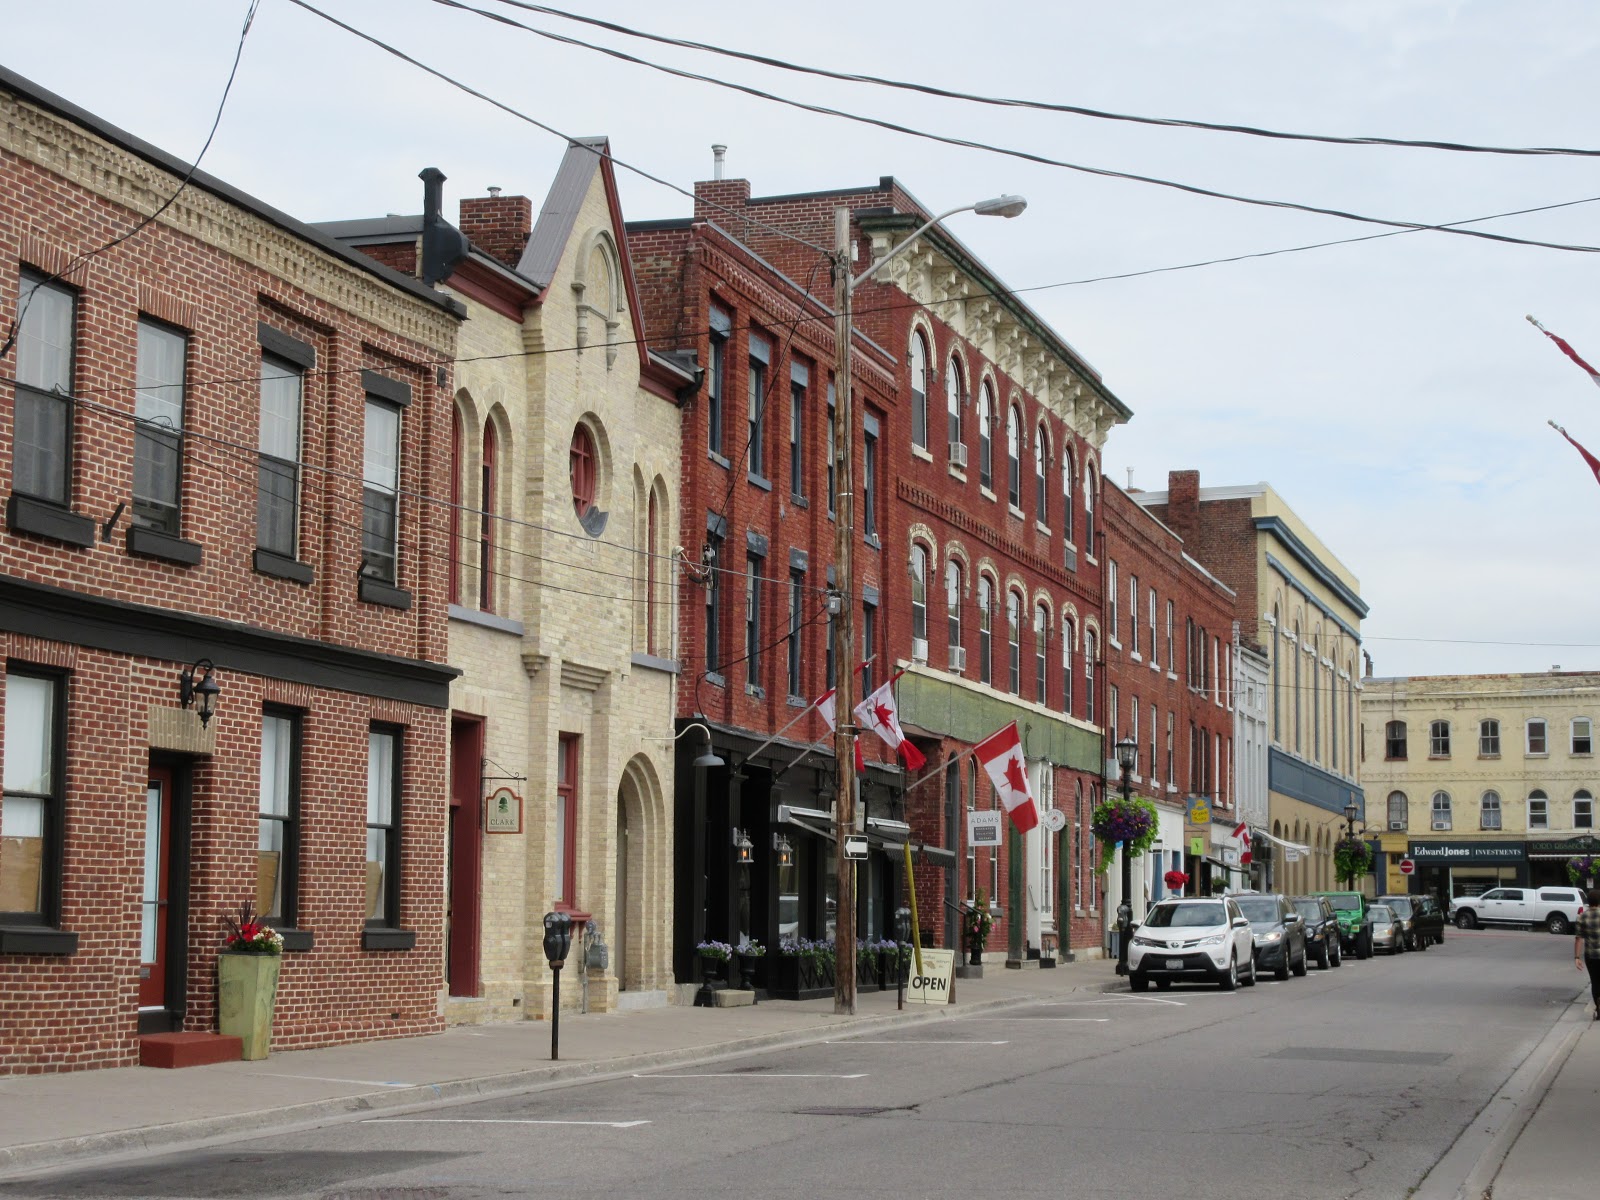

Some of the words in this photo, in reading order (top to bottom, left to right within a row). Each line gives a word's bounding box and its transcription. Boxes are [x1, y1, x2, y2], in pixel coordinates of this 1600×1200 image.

[490, 818, 515, 826] CLARK
[970, 816, 999, 824] ADAMS
[1475, 848, 1522, 856] INVESTMENTS
[912, 976, 947, 991] OPEN
